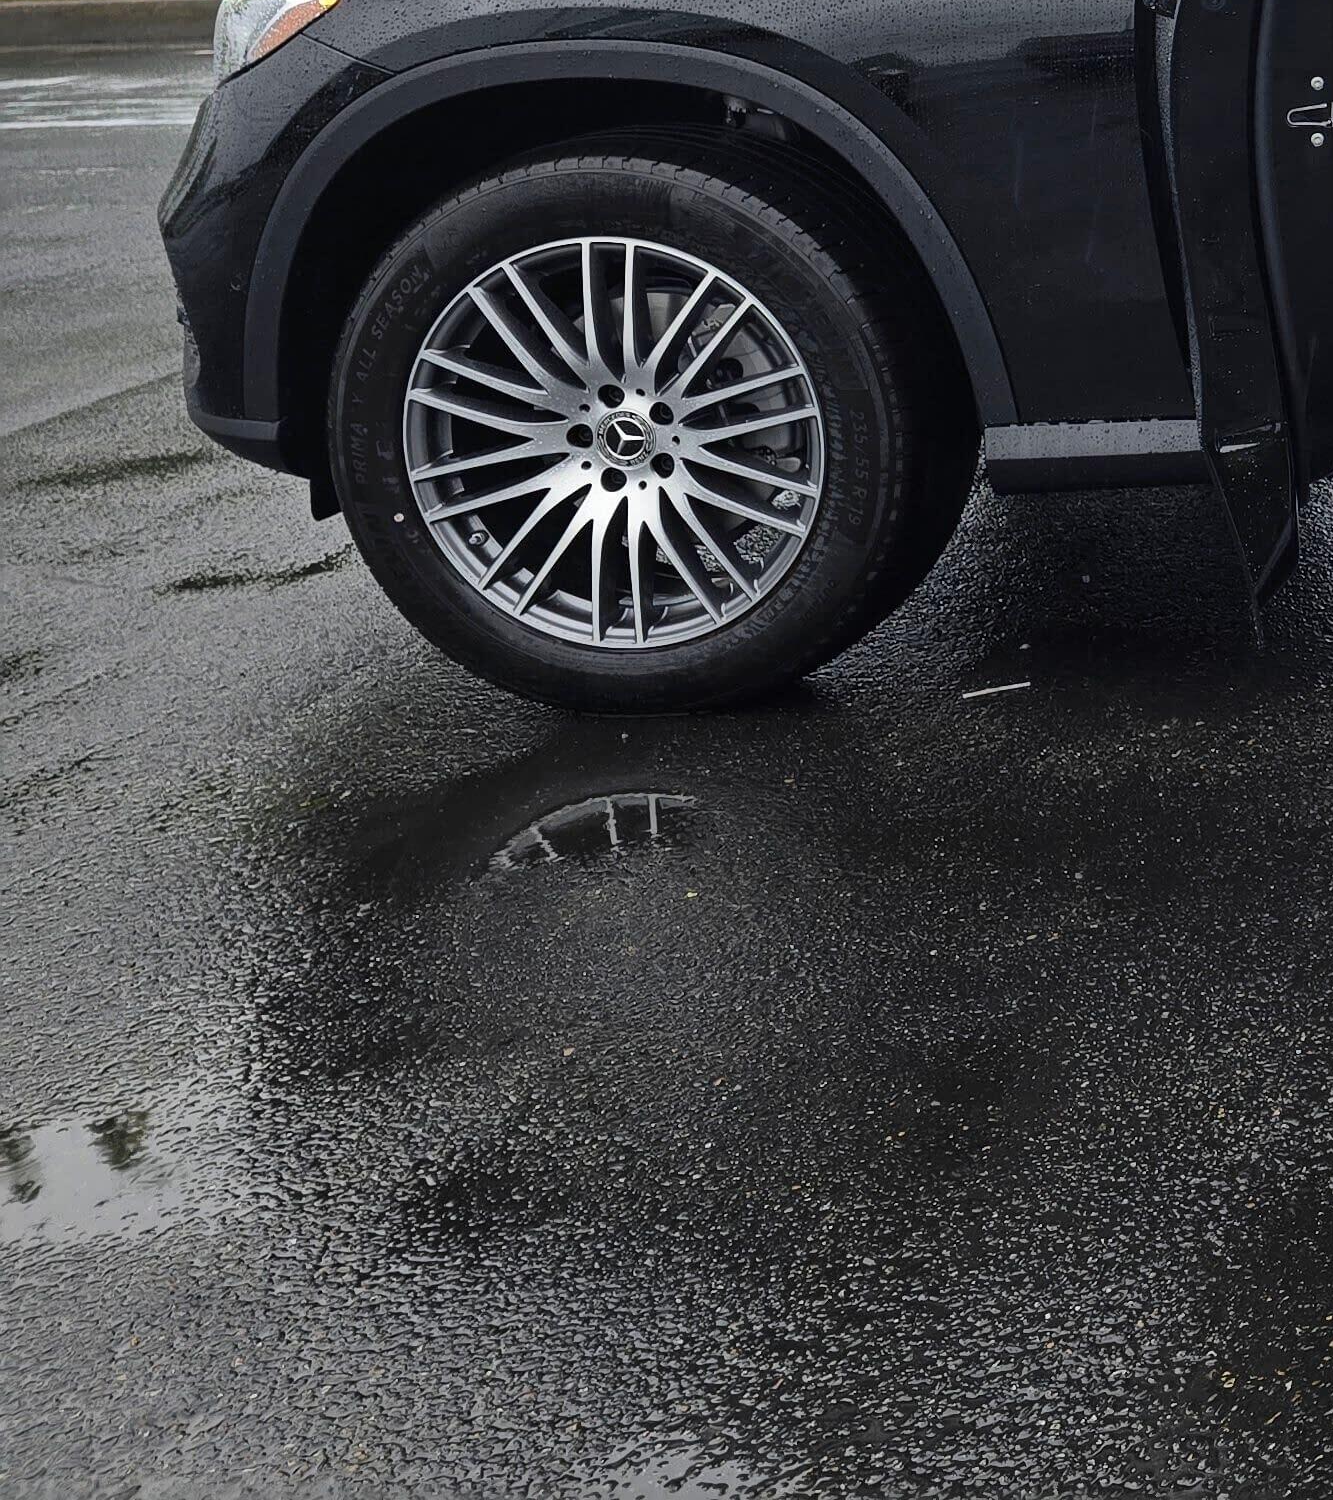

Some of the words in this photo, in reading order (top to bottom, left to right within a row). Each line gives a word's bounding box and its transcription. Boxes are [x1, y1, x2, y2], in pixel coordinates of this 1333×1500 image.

[370, 264, 424, 341] SEASON
[355, 347, 378, 383] ALL
[349, 389, 371, 485] PRIMAY
[850, 410, 870, 484] 235/55
